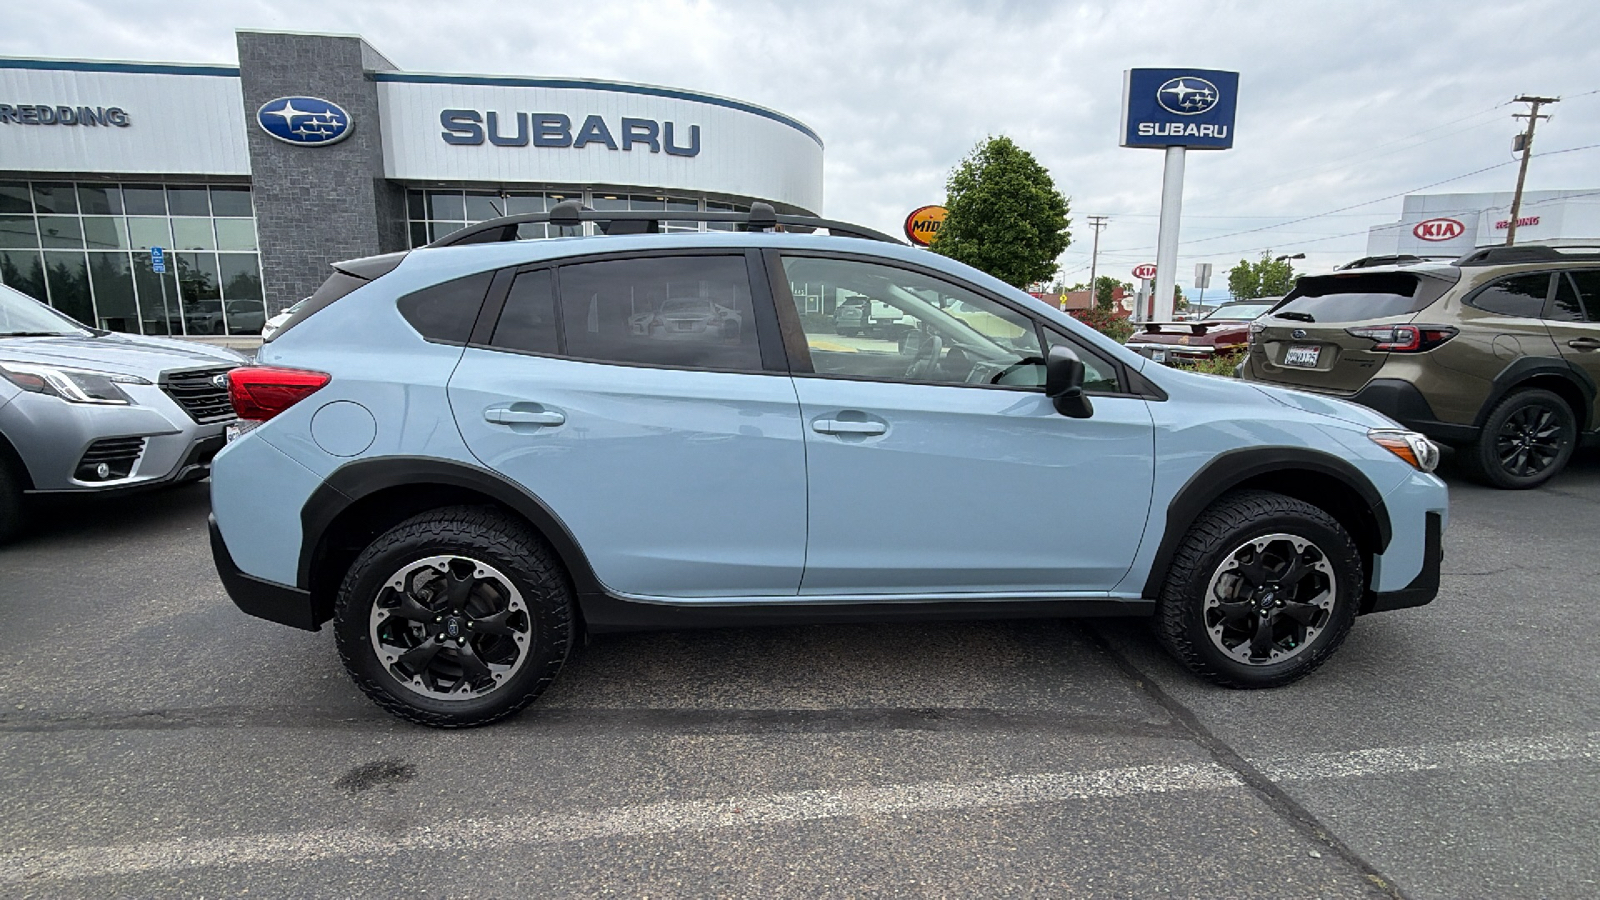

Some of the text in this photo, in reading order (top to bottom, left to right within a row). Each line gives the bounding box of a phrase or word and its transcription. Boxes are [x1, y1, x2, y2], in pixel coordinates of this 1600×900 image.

[0, 104, 130, 127] REDDING
[440, 109, 700, 157] SUBARU
[1138, 122, 1227, 138] SUBARU
[912, 220, 942, 232] MID
[1422, 222, 1456, 237] KIA
[1495, 216, 1540, 229] REDING
